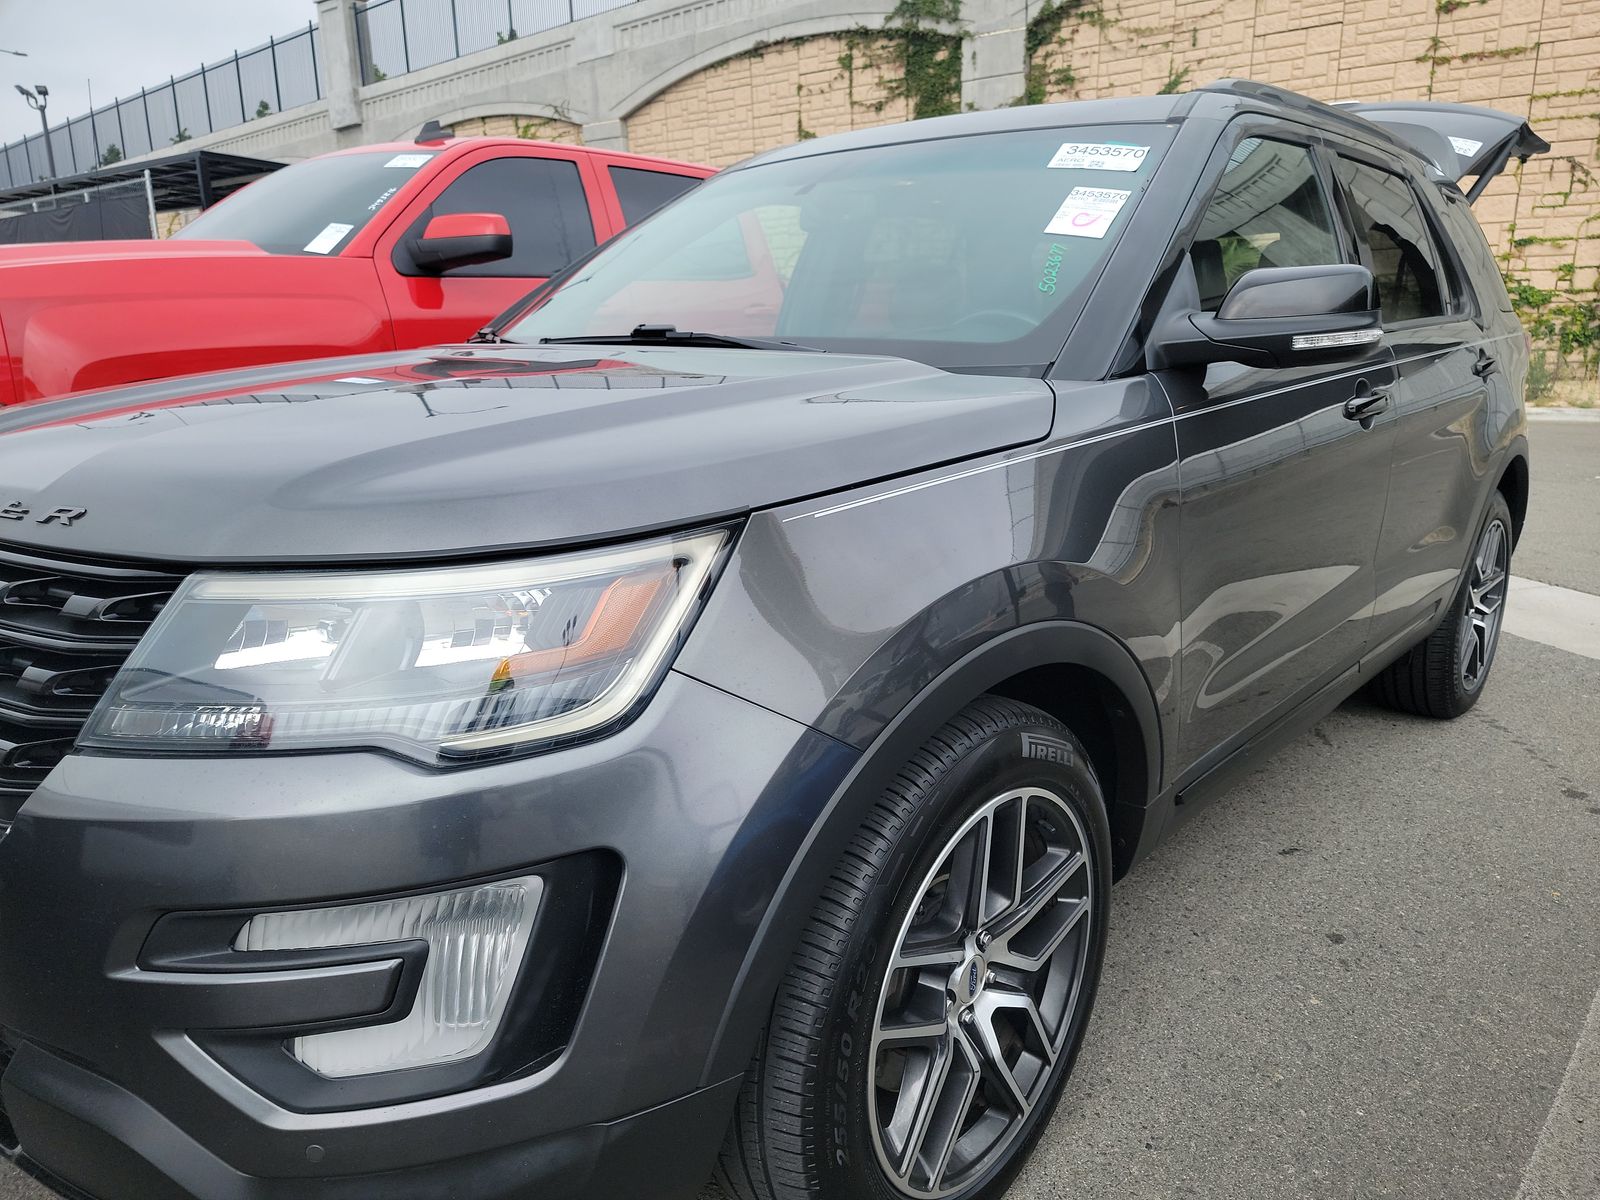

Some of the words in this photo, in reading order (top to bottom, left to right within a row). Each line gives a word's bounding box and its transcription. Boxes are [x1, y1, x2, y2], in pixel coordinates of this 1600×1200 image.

[1066, 145, 1145, 159] 3453570
[1070, 189, 1128, 201] 3453570
[1020, 732, 1074, 767] PIRELLI
[834, 1032, 853, 1167] 255/50
